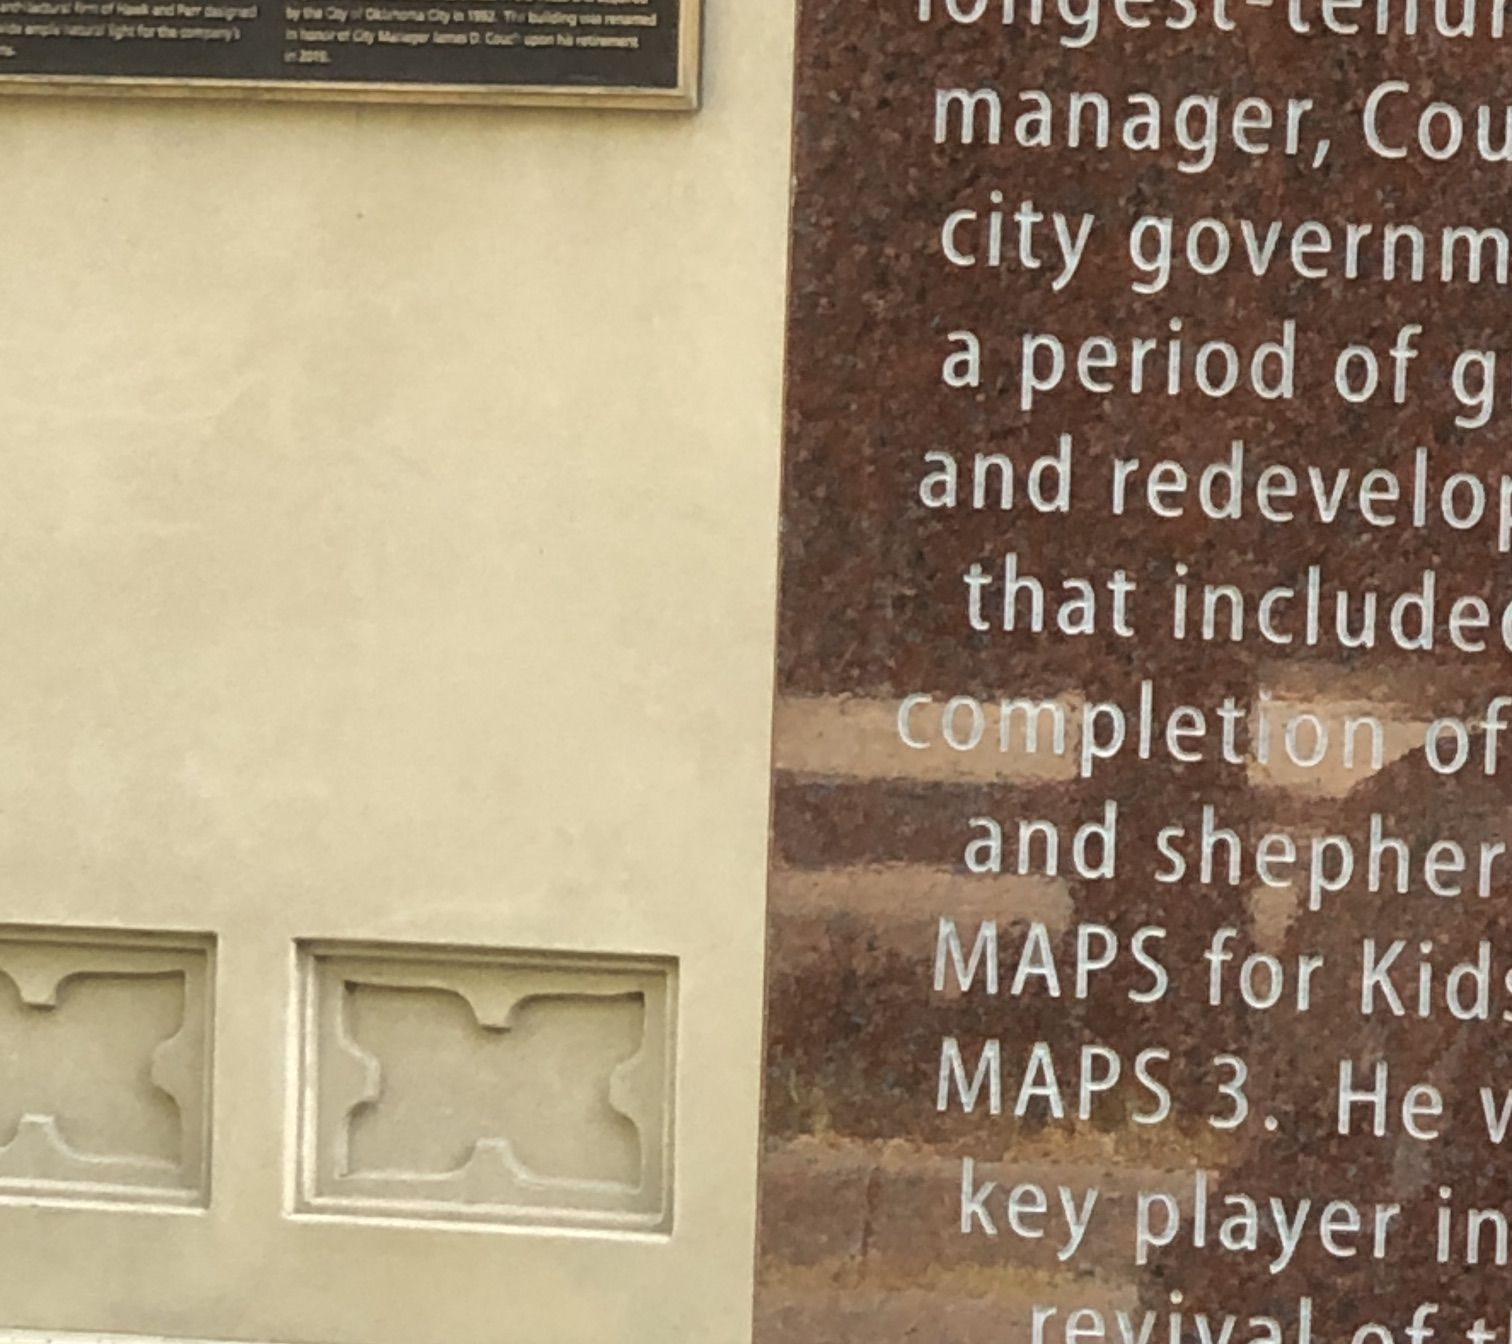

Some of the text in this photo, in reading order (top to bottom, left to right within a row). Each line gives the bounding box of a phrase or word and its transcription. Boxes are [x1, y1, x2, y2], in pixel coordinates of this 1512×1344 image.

[934, 88, 1329, 174] manager,
[941, 191, 1094, 291] city
[942, 331, 980, 388] a
[1020, 318, 1295, 411] period
[1334, 325, 1422, 403] of
[919, 434, 1072, 513] and
[963, 553, 1135, 638] that
[896, 680, 1383, 779] completion
[1424, 696, 1512, 775] of
[964, 800, 1117, 880] and
[933, 917, 1169, 1004] MAPS
[1204, 927, 1324, 1012] for
[936, 1038, 1171, 1124] MAPS
[1211, 1055, 1278, 1130] 3.
[1337, 1060, 1443, 1141] He
[960, 1159, 1099, 1262] key
[1135, 1173, 1401, 1275] player
[1437, 1187, 1508, 1266] in
